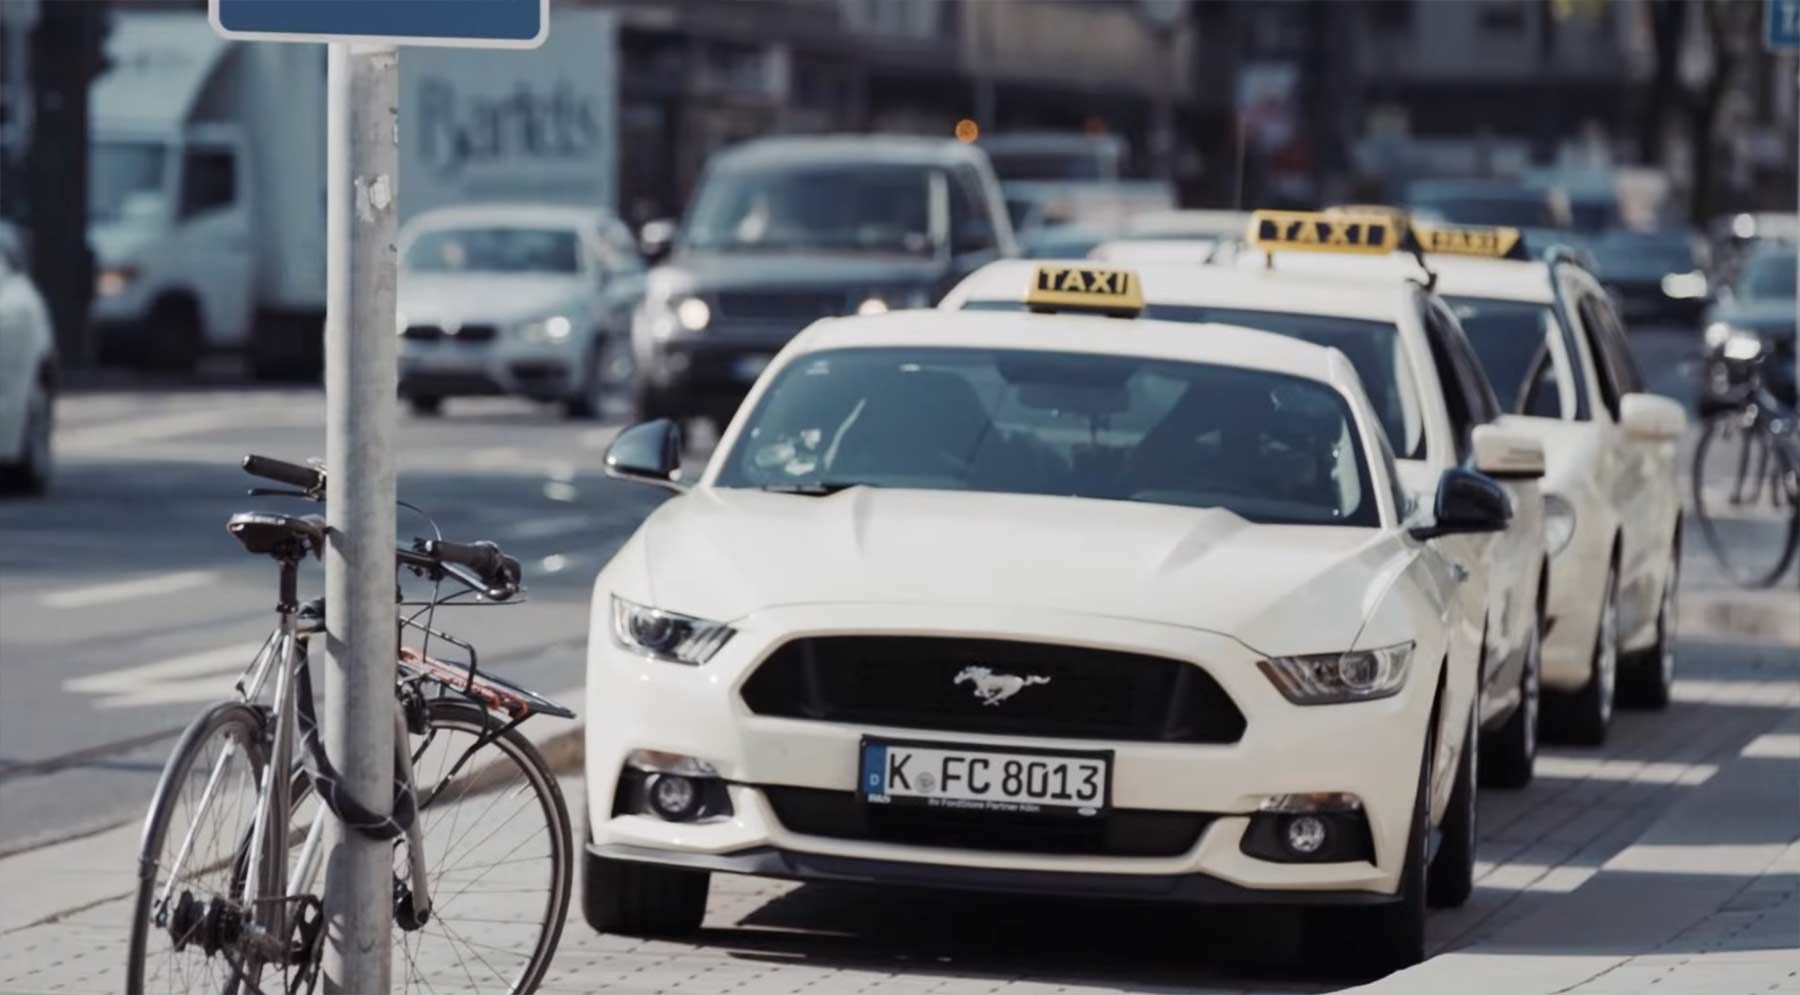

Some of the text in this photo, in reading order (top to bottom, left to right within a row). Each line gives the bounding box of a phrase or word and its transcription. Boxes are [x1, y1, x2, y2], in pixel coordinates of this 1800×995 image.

[1266, 219, 1378, 246] TAXI
[1040, 267, 1127, 294] TAXI
[869, 773, 880, 786] D
[889, 753, 1099, 801] K FC 8013
